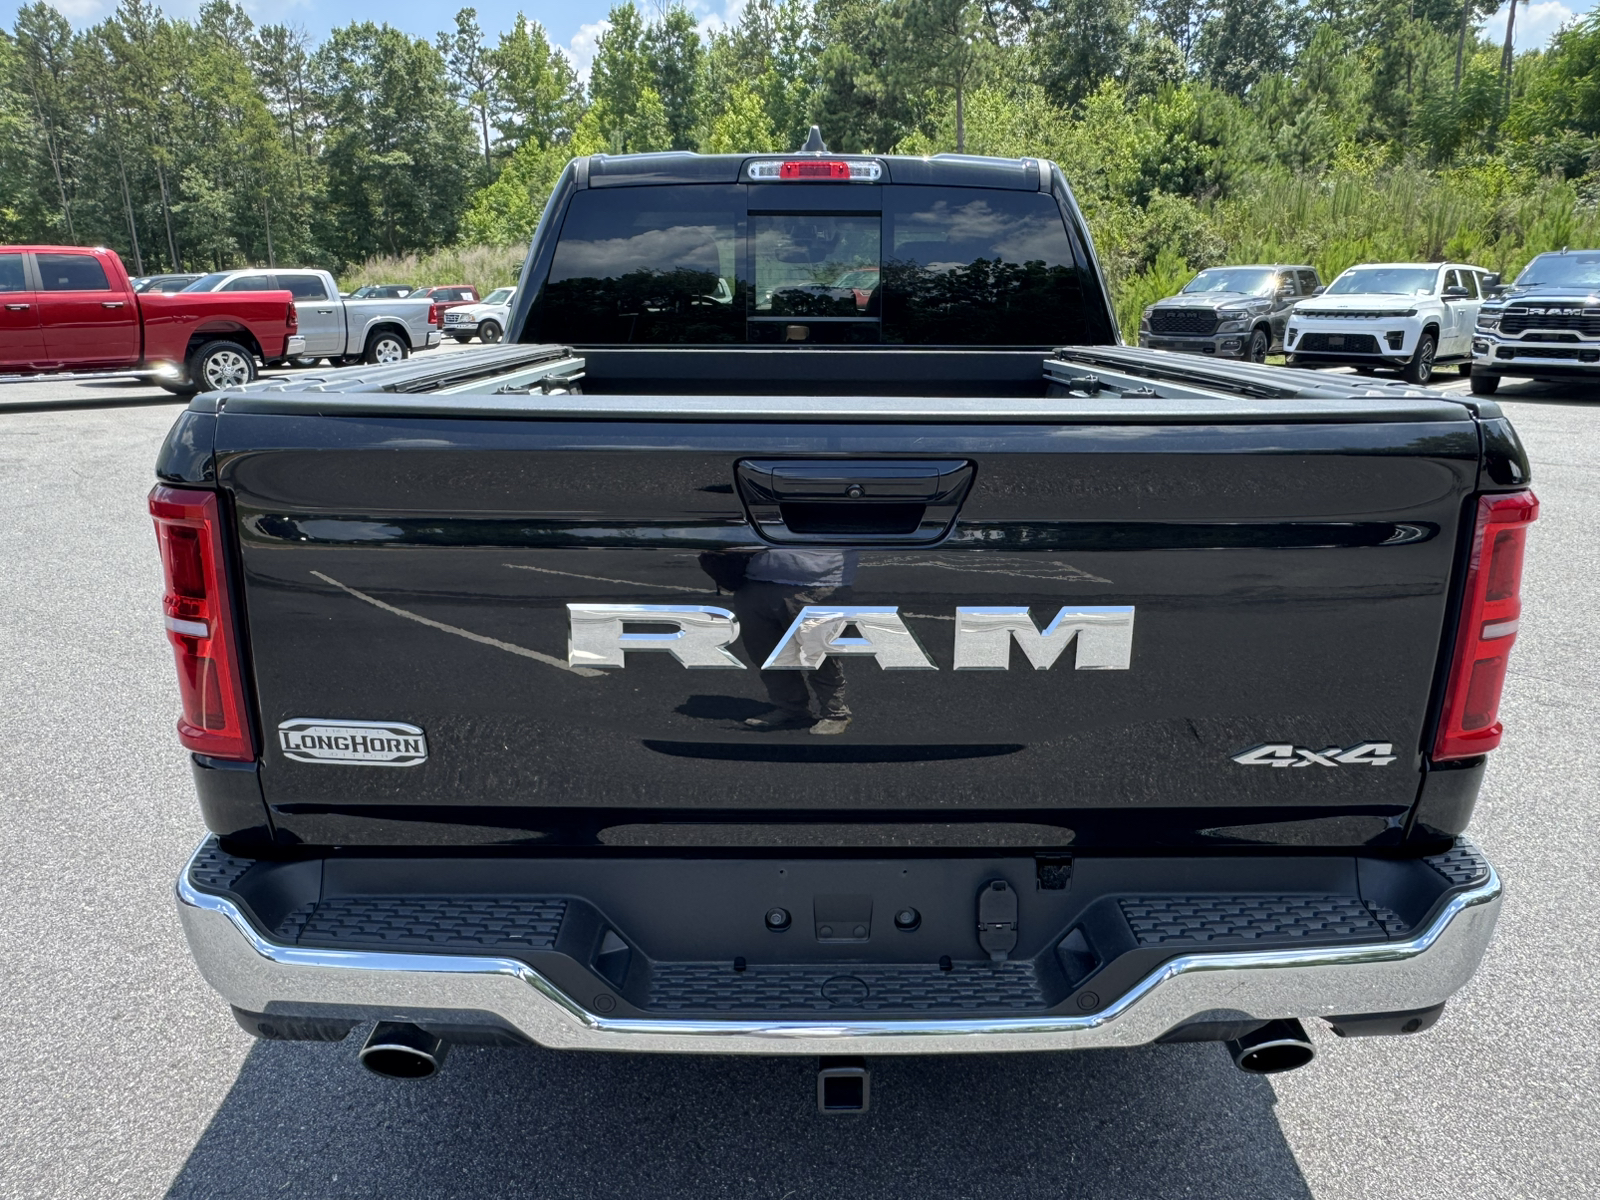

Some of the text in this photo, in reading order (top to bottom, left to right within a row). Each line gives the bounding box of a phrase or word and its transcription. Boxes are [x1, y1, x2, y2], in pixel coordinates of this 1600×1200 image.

[1529, 307, 1582, 316] RAM
[566, 602, 1135, 671] RAM
[281, 731, 423, 754] LONGHORN
